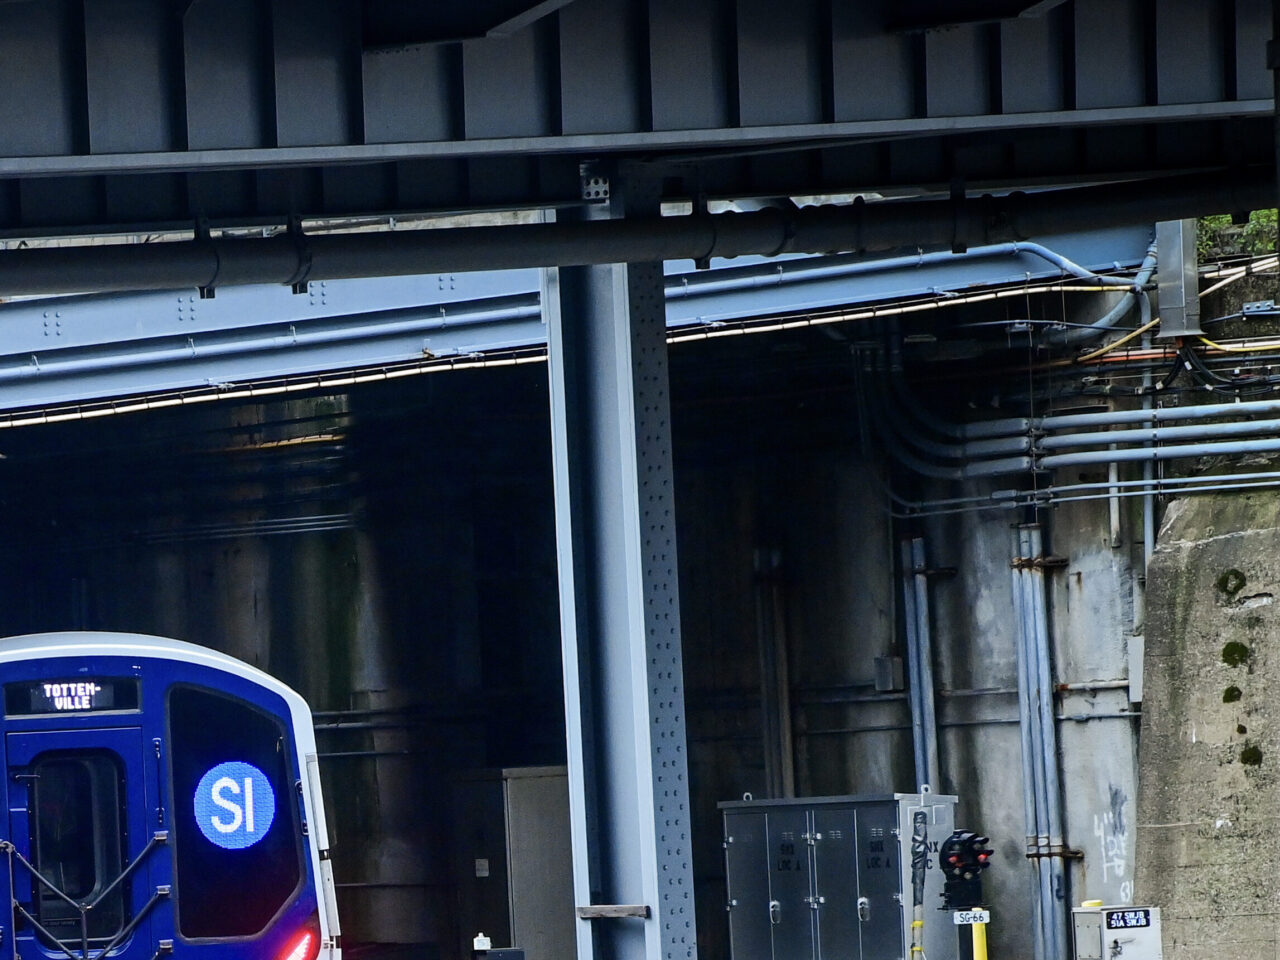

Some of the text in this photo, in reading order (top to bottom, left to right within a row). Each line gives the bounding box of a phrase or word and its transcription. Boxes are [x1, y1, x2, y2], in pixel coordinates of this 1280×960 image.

[43, 682, 101, 697] TOTTEN-
[54, 696, 91, 710] VILLE
[210, 776, 255, 833] SI
[959, 912, 985, 923] SG-66
[1111, 912, 1123, 920] 47
